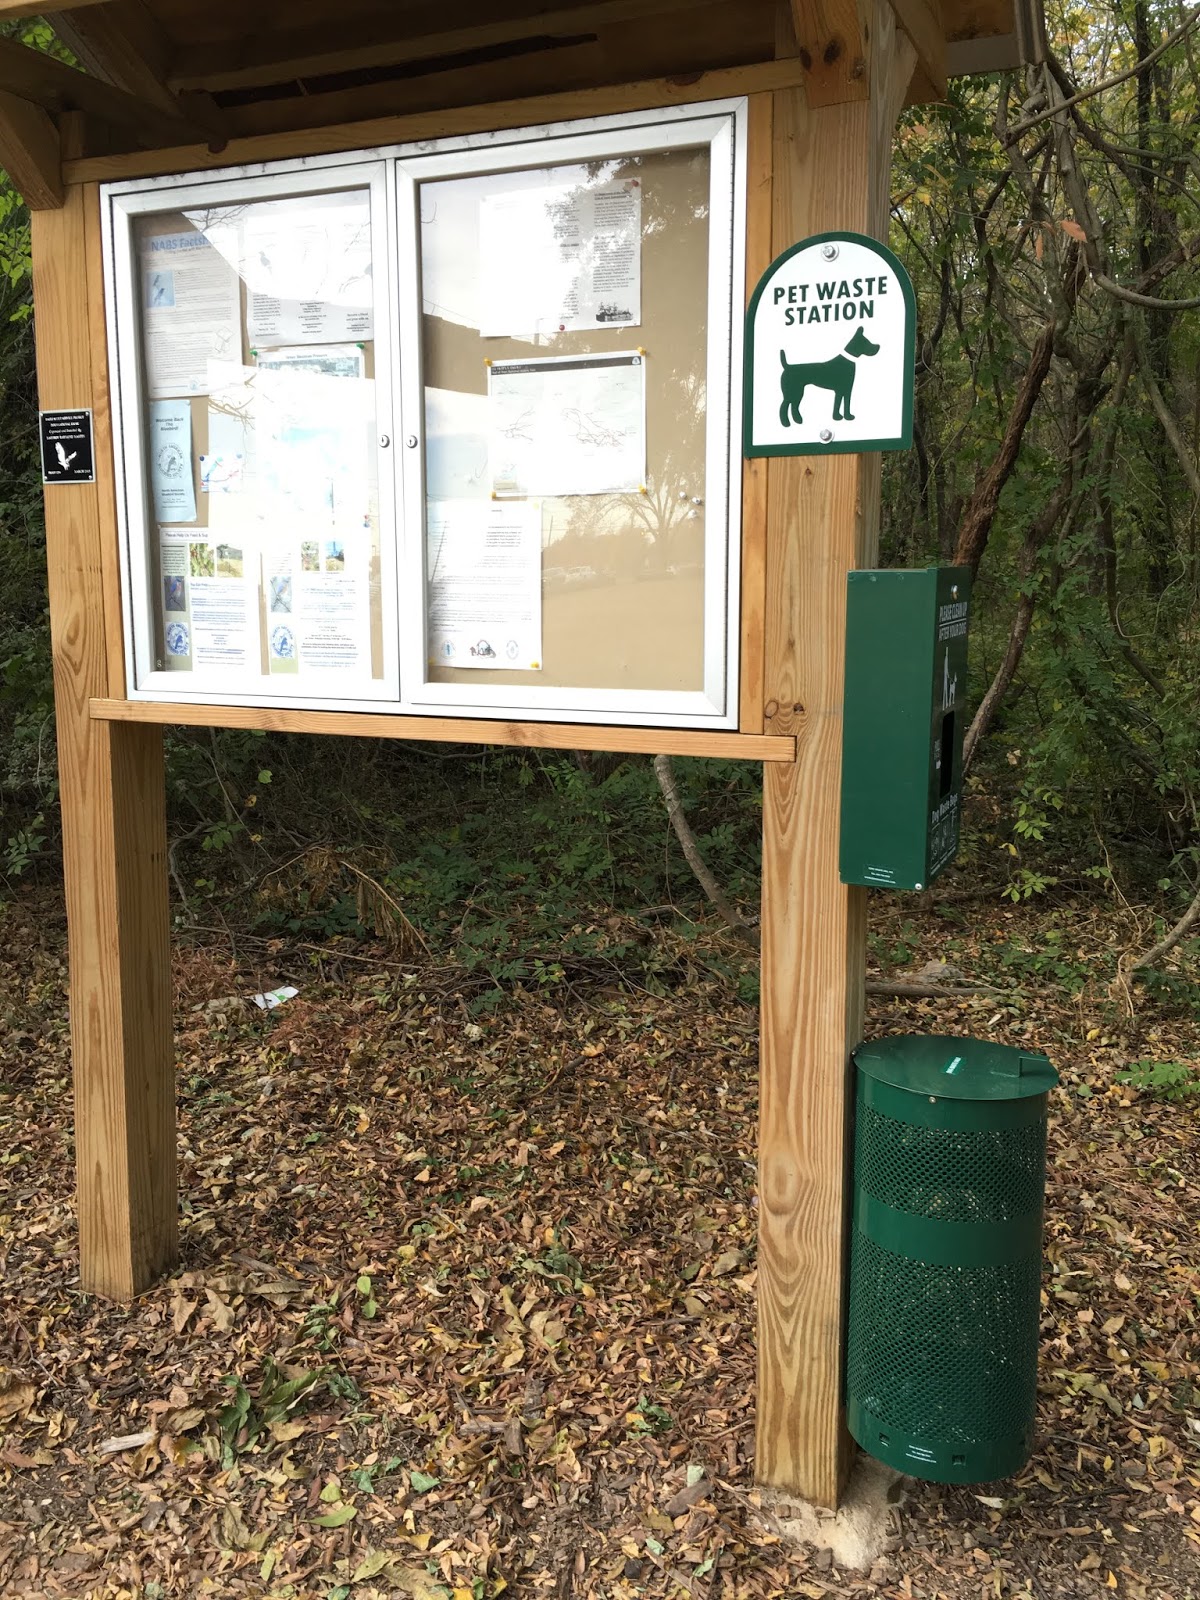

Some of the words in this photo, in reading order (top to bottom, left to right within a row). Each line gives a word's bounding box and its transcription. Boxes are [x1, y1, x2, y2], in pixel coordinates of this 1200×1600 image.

[151, 238, 178, 252] NABS
[773, 284, 809, 305] PET
[816, 275, 888, 301] WASTE
[785, 300, 875, 326] STATION
